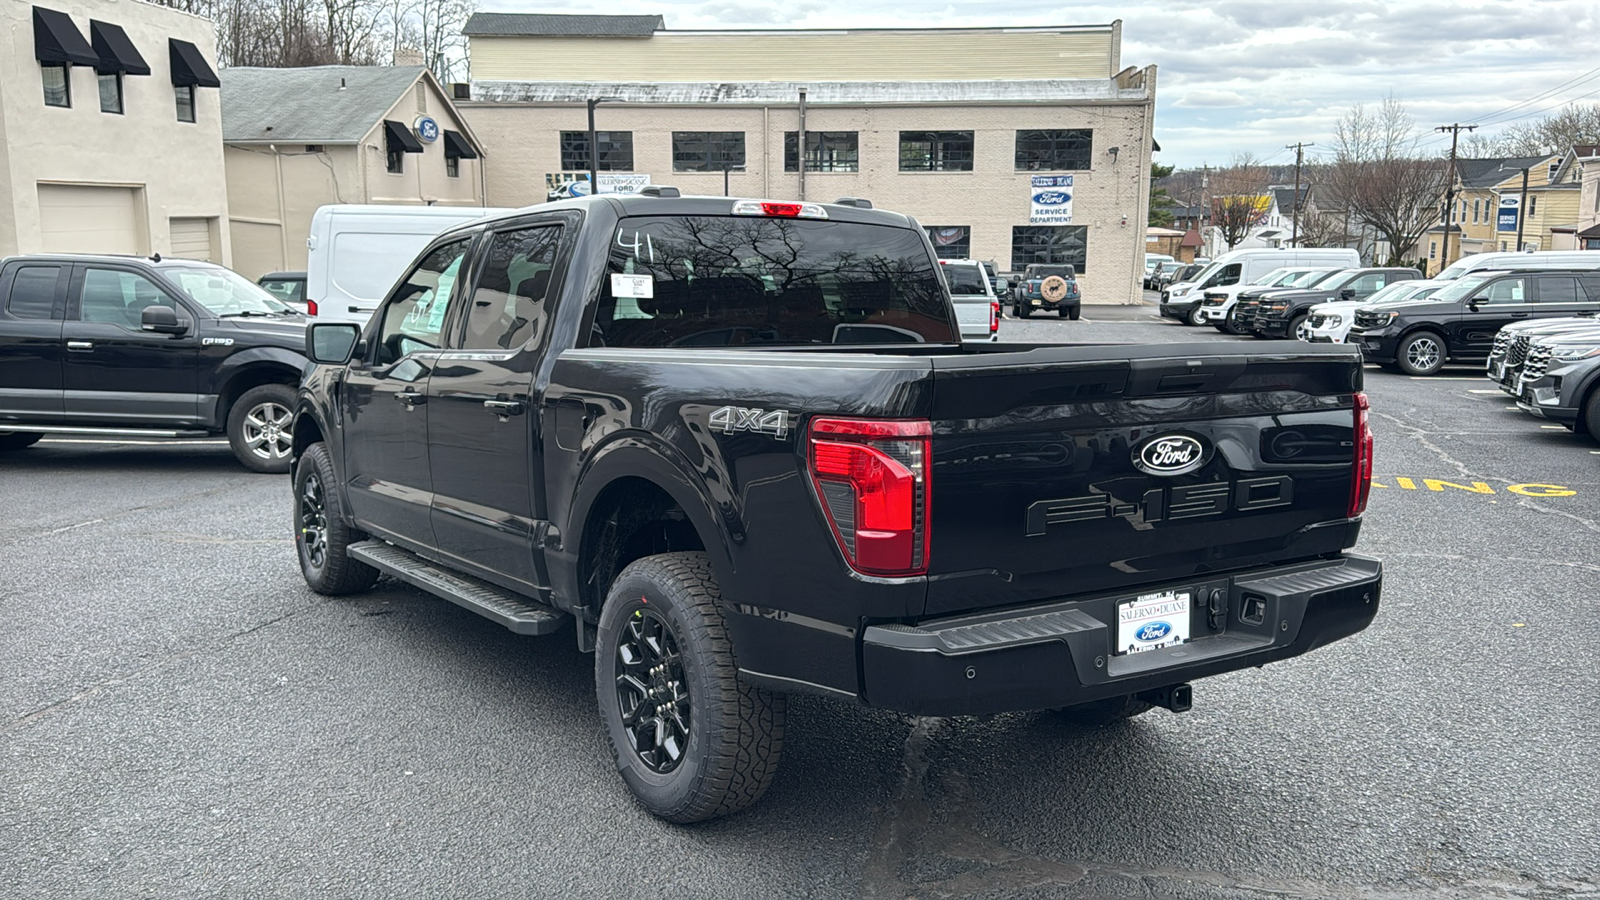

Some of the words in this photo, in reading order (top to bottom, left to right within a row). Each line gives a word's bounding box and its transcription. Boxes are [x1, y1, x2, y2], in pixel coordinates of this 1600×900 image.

[423, 122, 436, 137] Ford
[1039, 192, 1065, 204] Ford
[617, 227, 654, 265] 41
[1152, 440, 1193, 465] Ford
[1371, 476, 1577, 497] ING
[1025, 475, 1293, 537] F-150
[1120, 606, 1156, 620] SALERNO
[1160, 601, 1187, 614] DUANE
[1141, 623, 1165, 640] Ford
